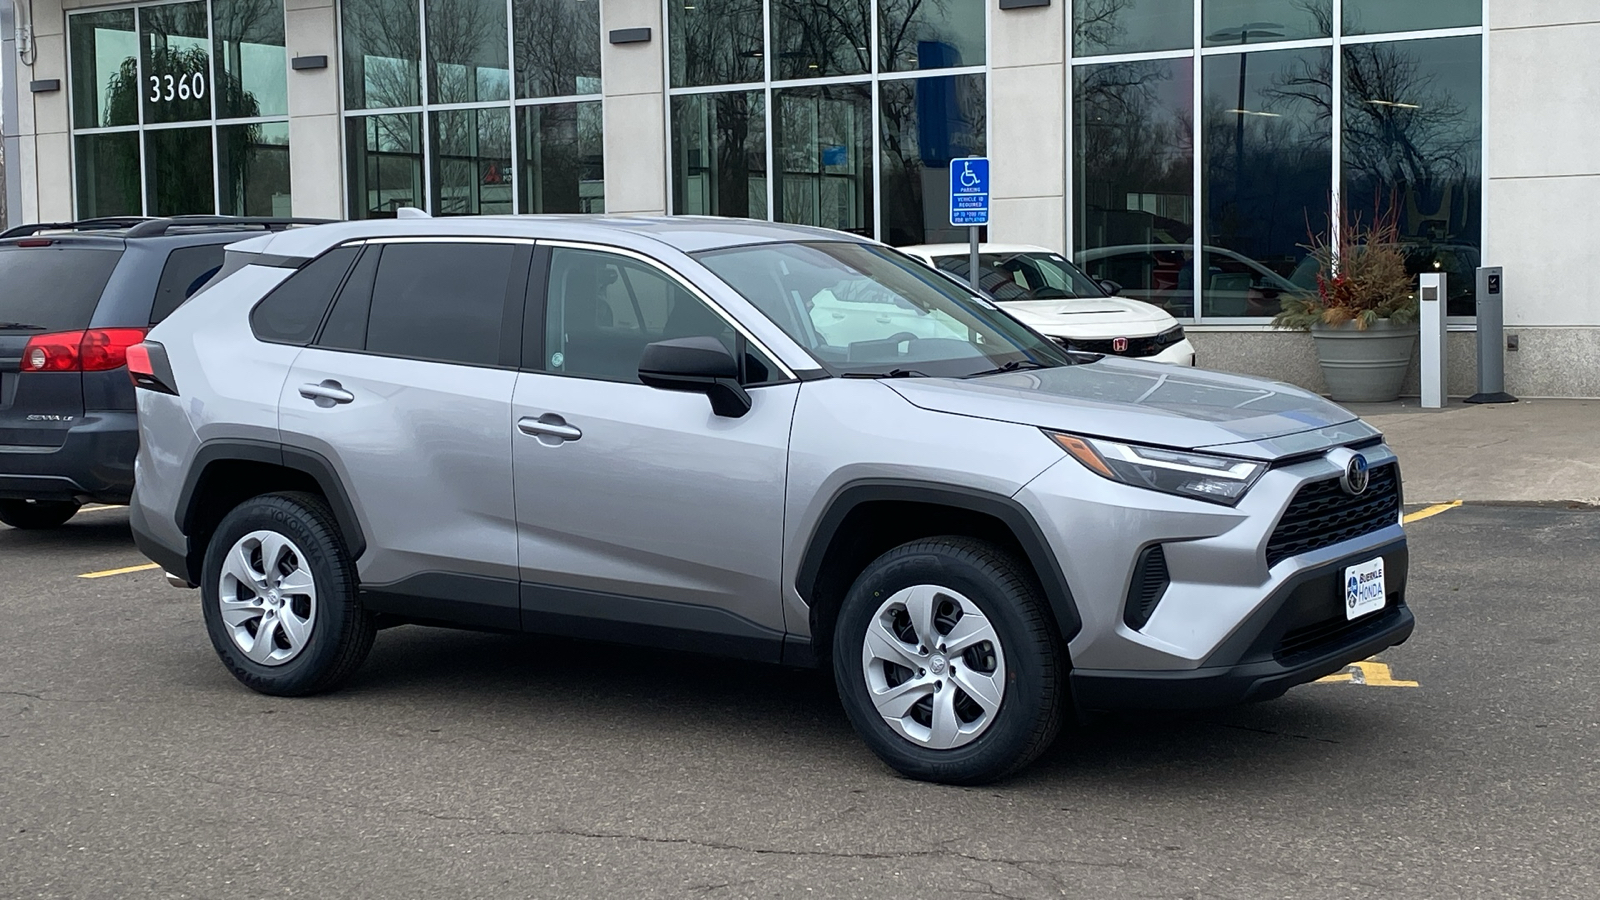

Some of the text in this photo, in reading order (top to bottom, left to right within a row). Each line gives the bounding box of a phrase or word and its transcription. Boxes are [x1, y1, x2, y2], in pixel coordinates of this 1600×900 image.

[150, 72, 204, 102] 3360
[270, 508, 322, 565] YOKOHAMA
[1360, 569, 1382, 584] BUERKLE
[1359, 583, 1383, 602] HONDA
